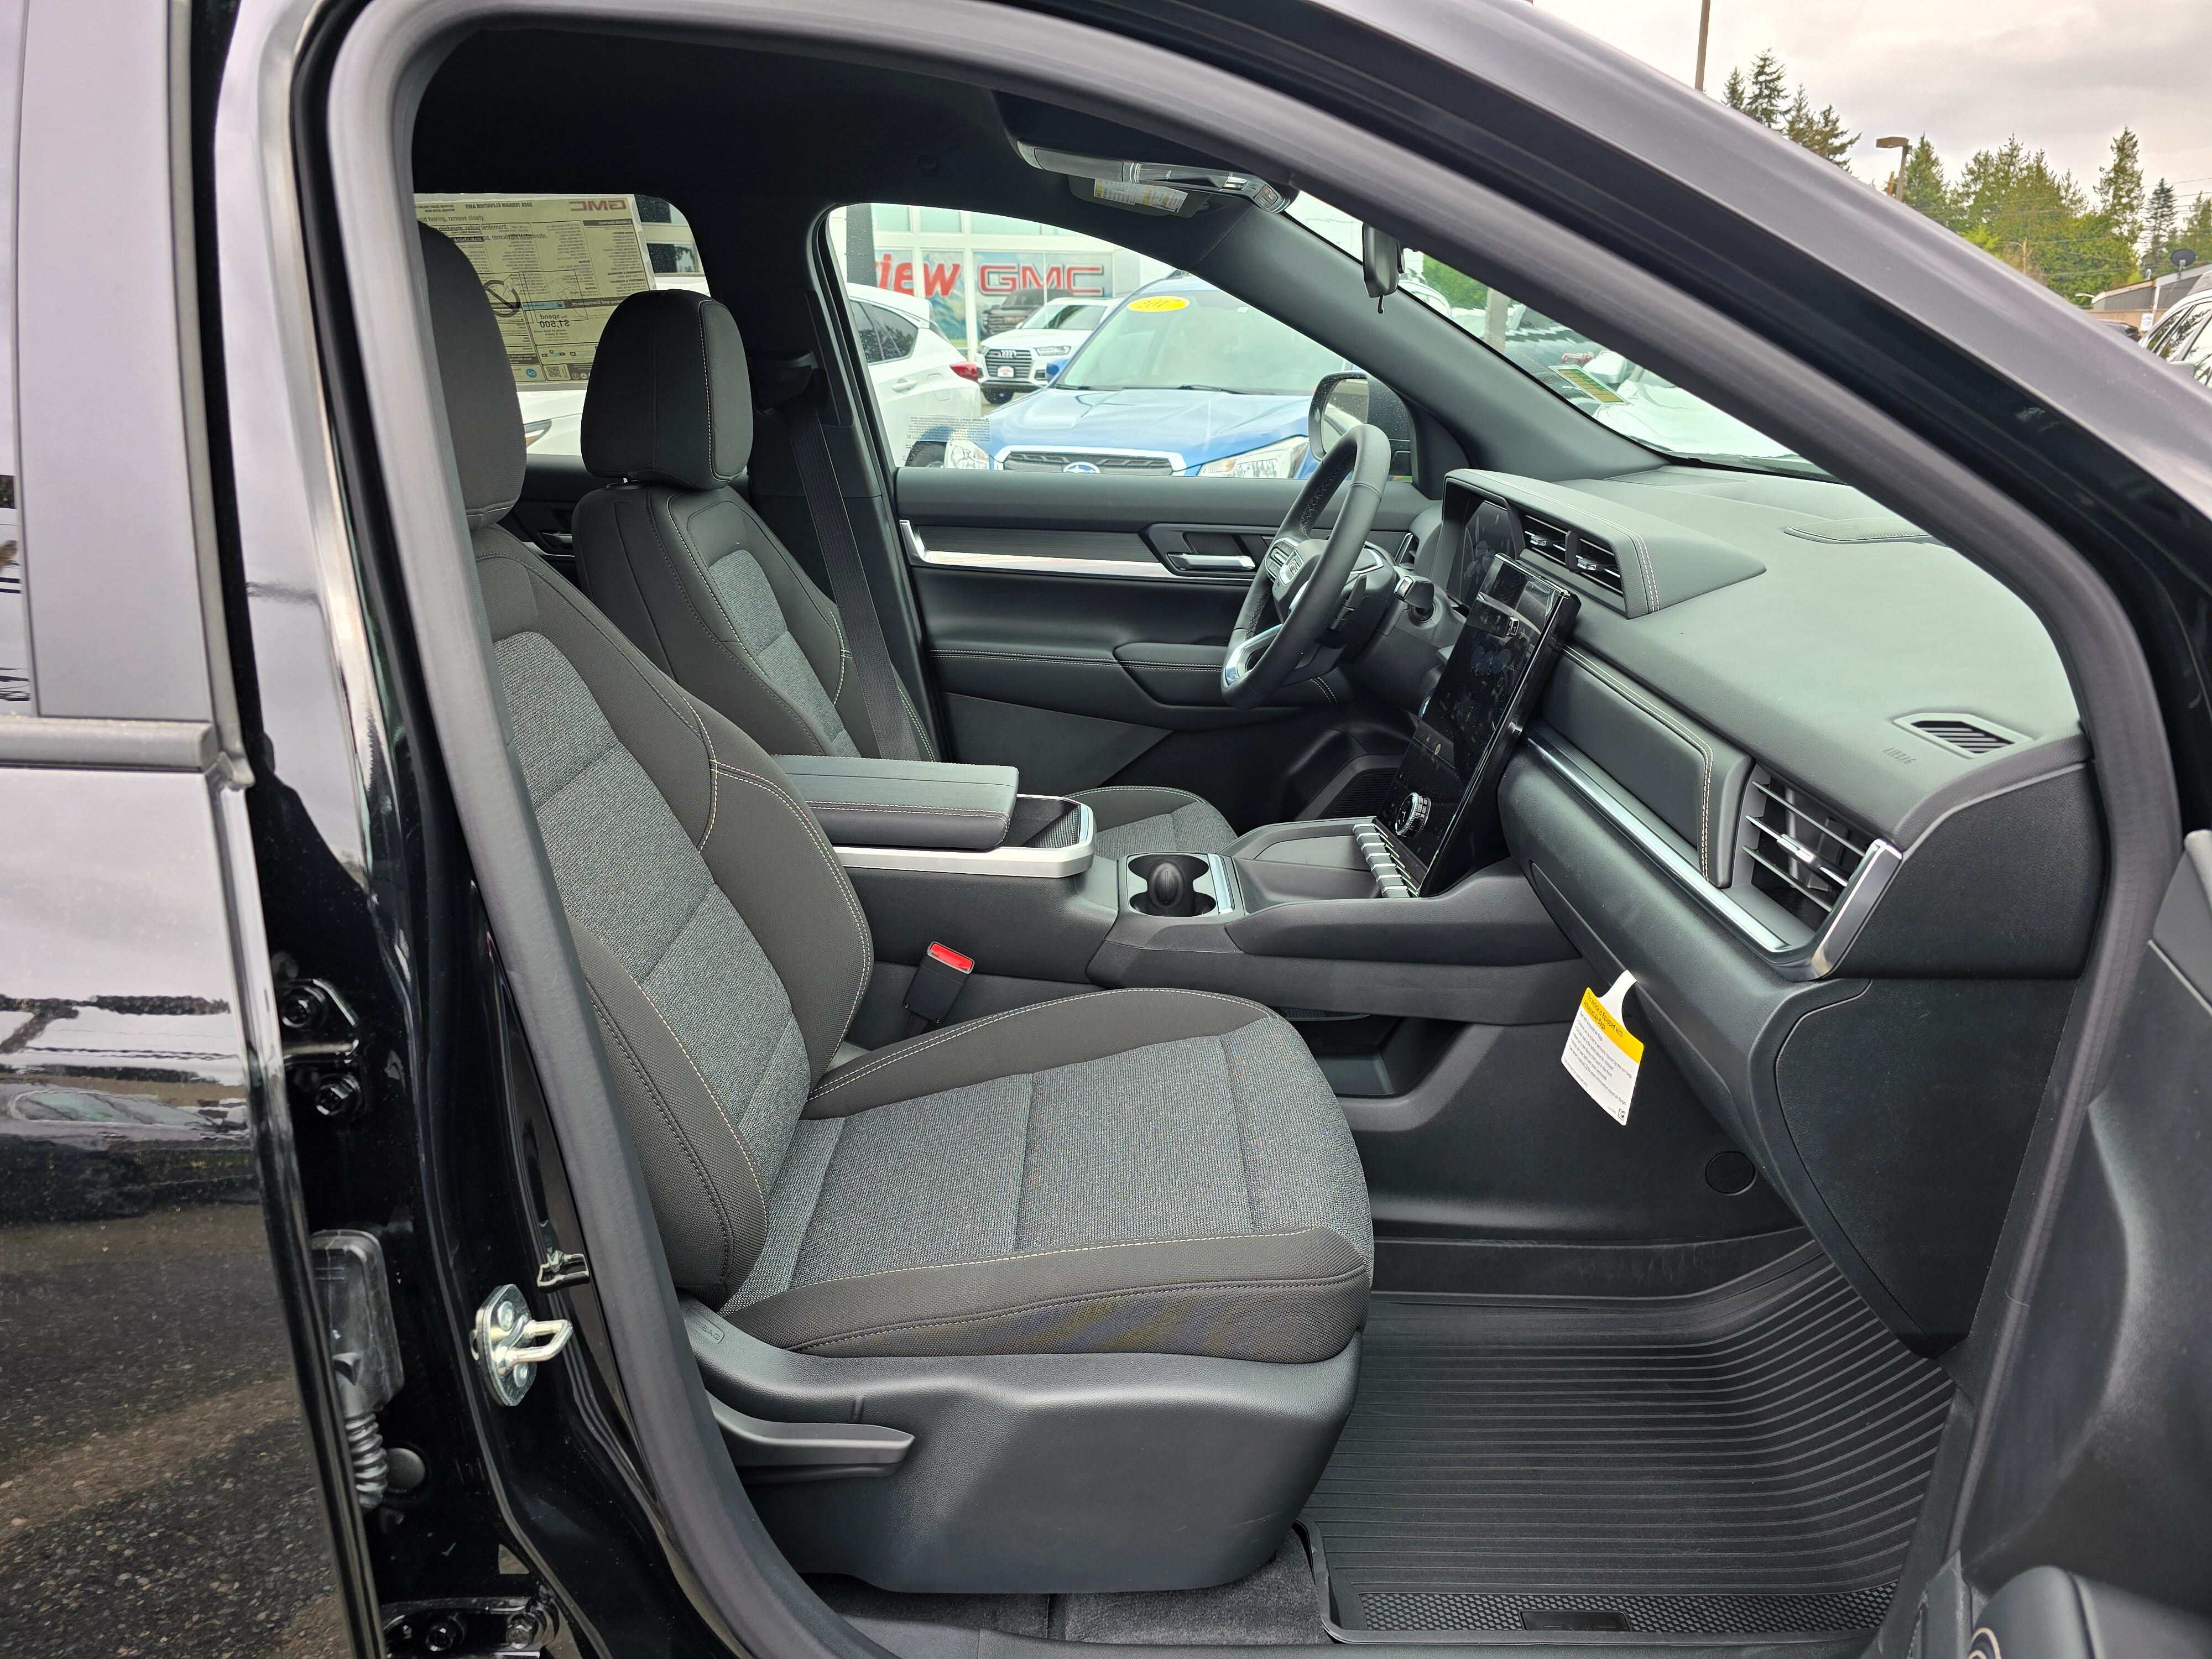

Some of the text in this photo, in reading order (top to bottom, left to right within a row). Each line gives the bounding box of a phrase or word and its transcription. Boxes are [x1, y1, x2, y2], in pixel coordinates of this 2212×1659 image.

[875, 253, 1104, 298] iew GMC
[1882, 747, 1917, 765] AIRBAG
[1598, 1018, 1606, 1030] Bags
[1602, 1012, 1615, 1030] Equipped
[687, 1314, 721, 1340] AIRBAG
